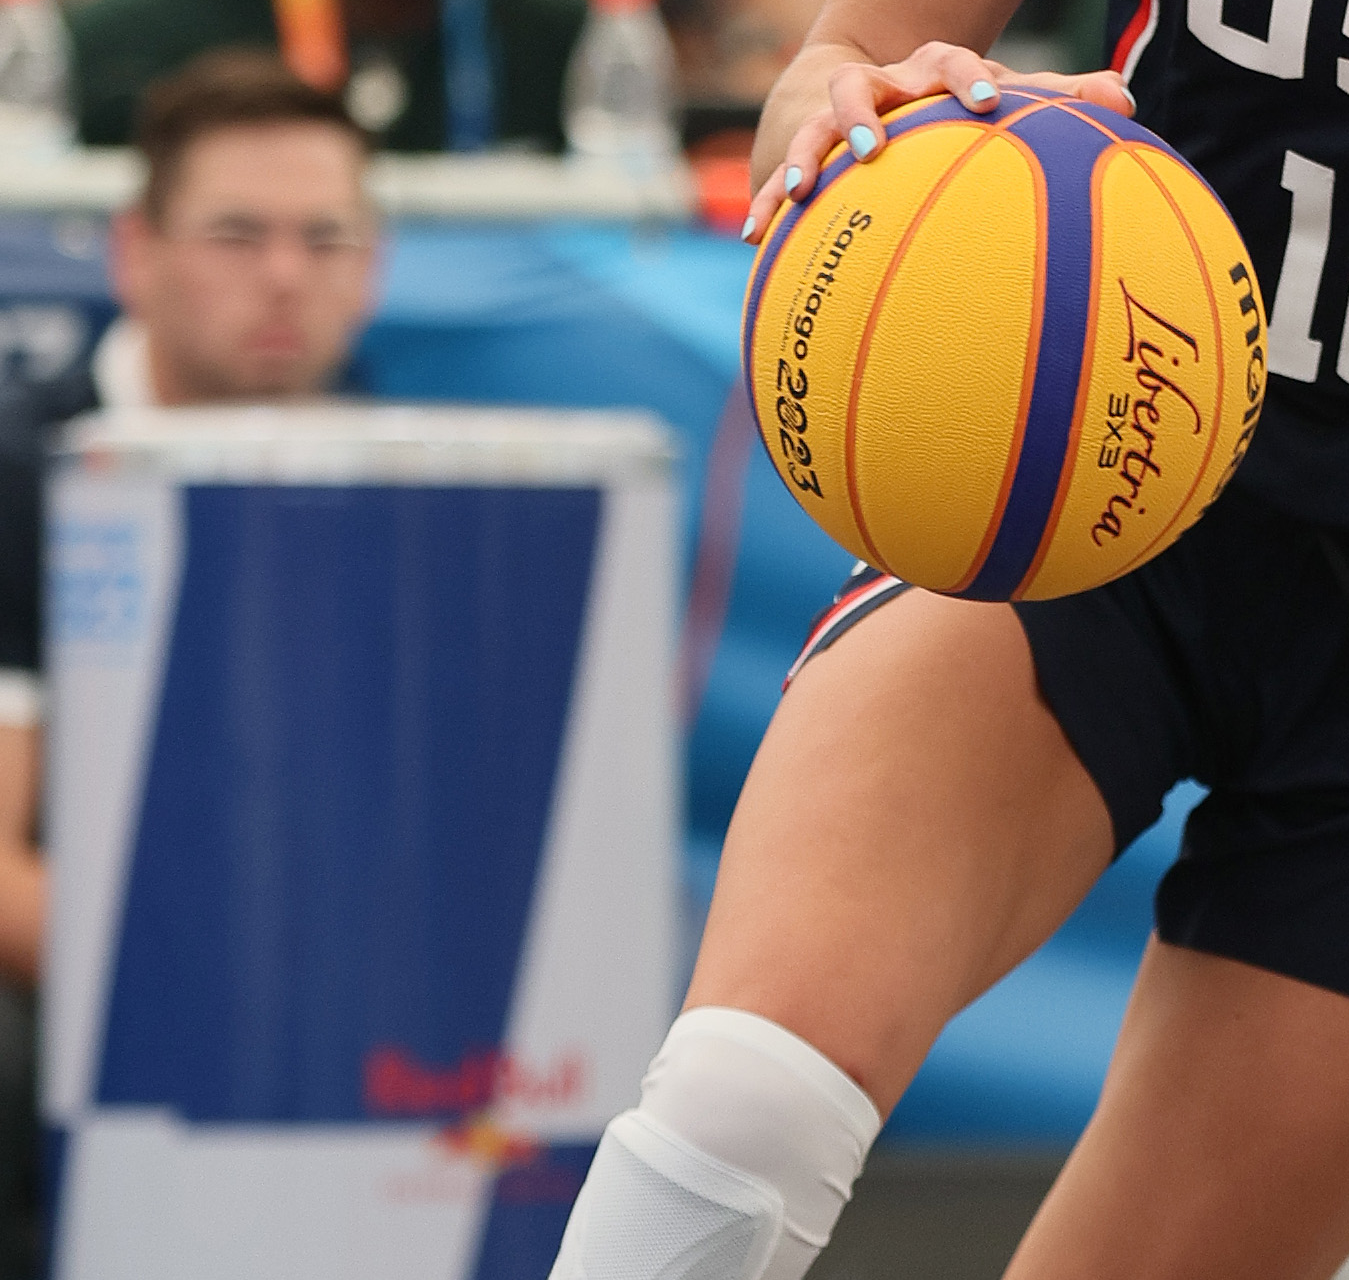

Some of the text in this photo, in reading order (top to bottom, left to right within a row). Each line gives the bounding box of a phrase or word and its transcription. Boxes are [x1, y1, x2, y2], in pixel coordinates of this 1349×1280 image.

[776, 209, 873, 500] Santiago 2023
[1091, 277, 1202, 547] Libertria
